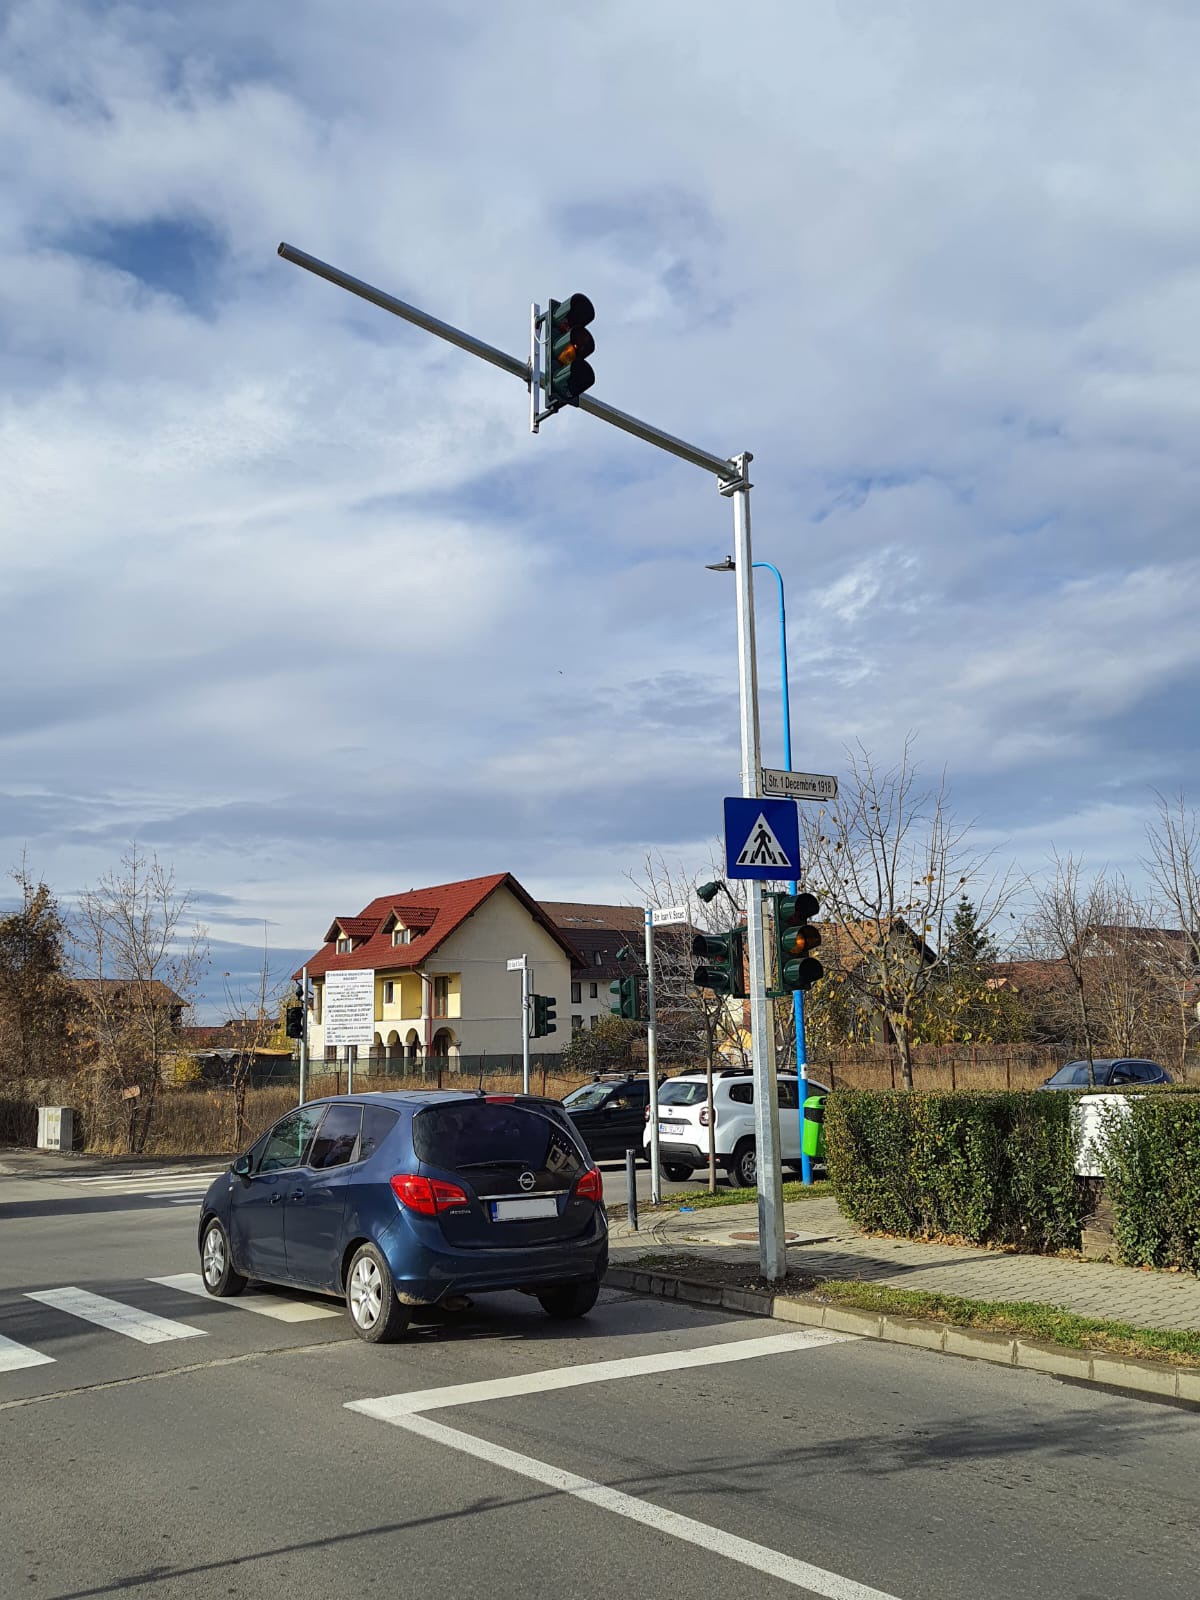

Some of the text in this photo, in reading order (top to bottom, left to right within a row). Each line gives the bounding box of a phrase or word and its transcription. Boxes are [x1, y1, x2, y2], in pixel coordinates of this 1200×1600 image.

[768, 774, 832, 793] Str. 1 Decembrie 1918
